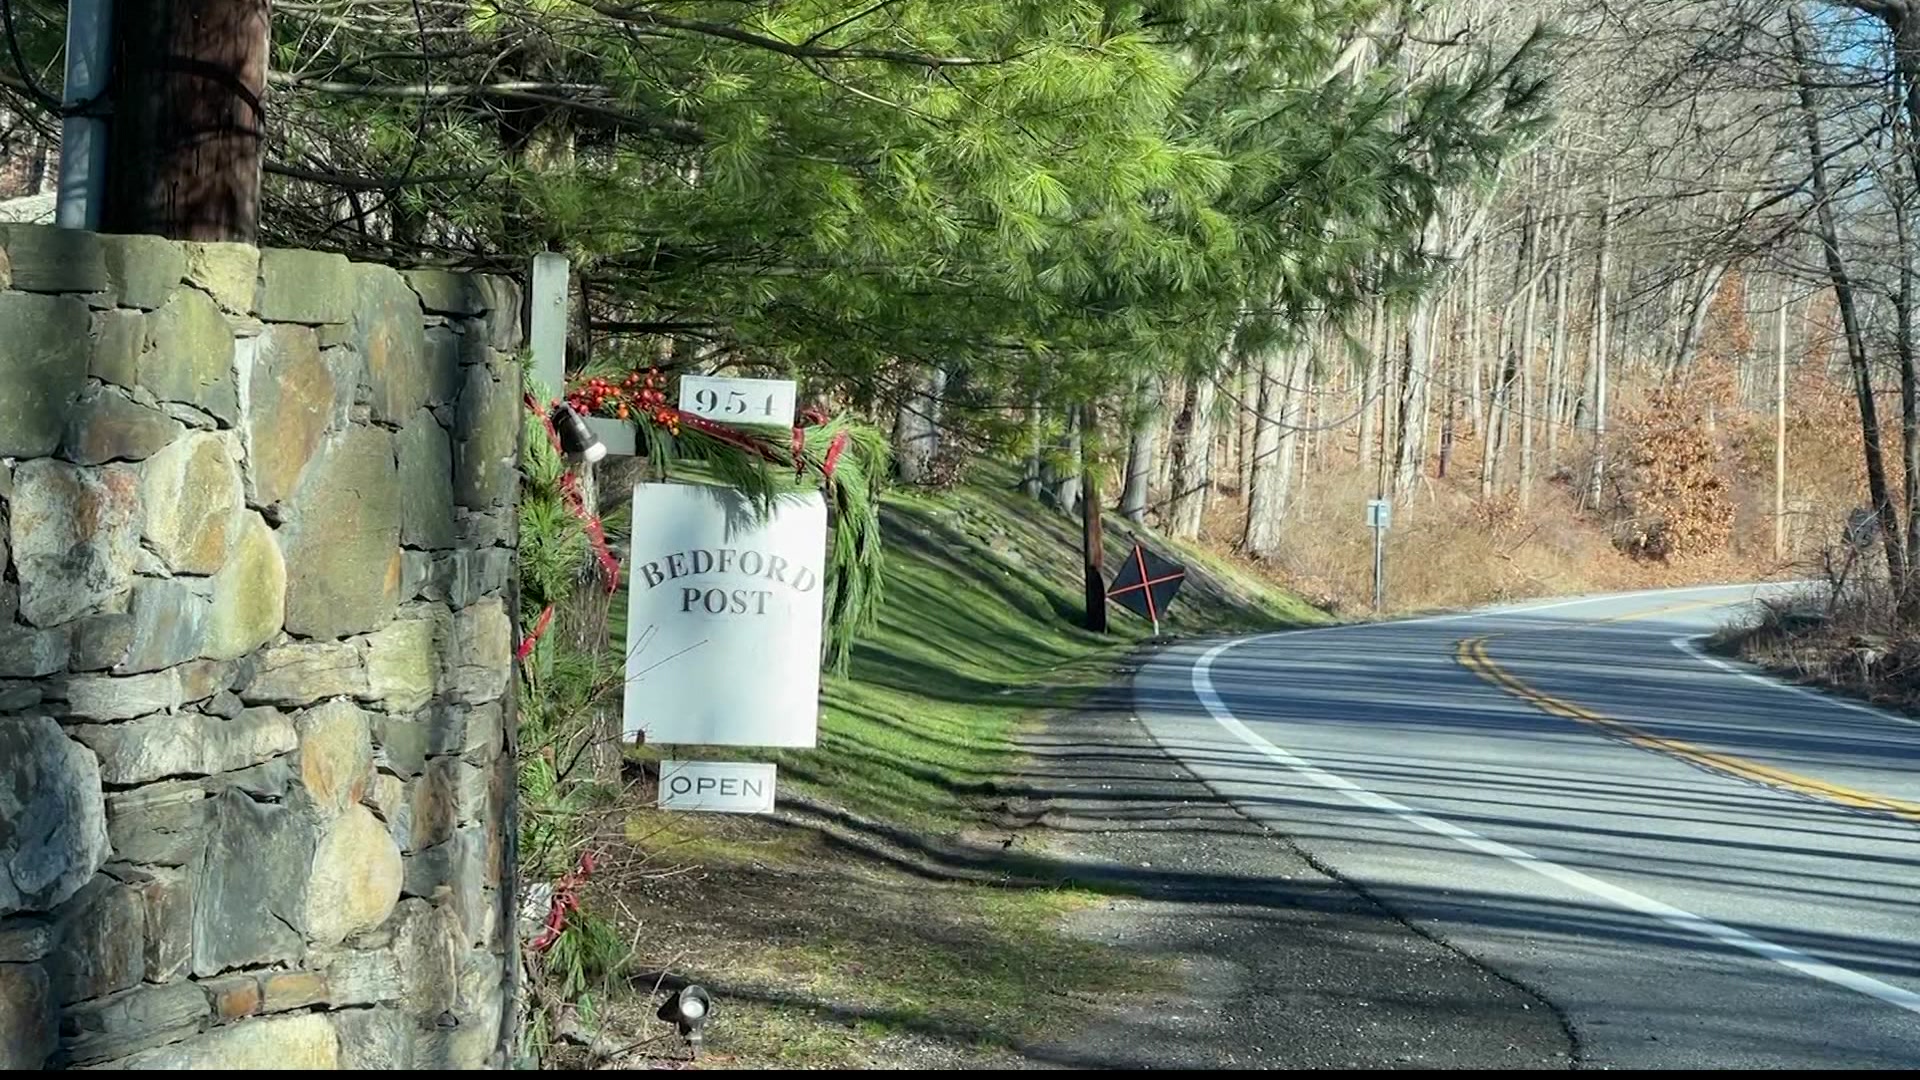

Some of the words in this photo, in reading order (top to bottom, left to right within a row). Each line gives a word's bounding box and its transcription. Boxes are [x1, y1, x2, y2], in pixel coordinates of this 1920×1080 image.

[695, 389, 777, 415] 954
[639, 549, 817, 593] BEDFORD
[681, 587, 772, 615] POST
[671, 776, 763, 797] OPEN
